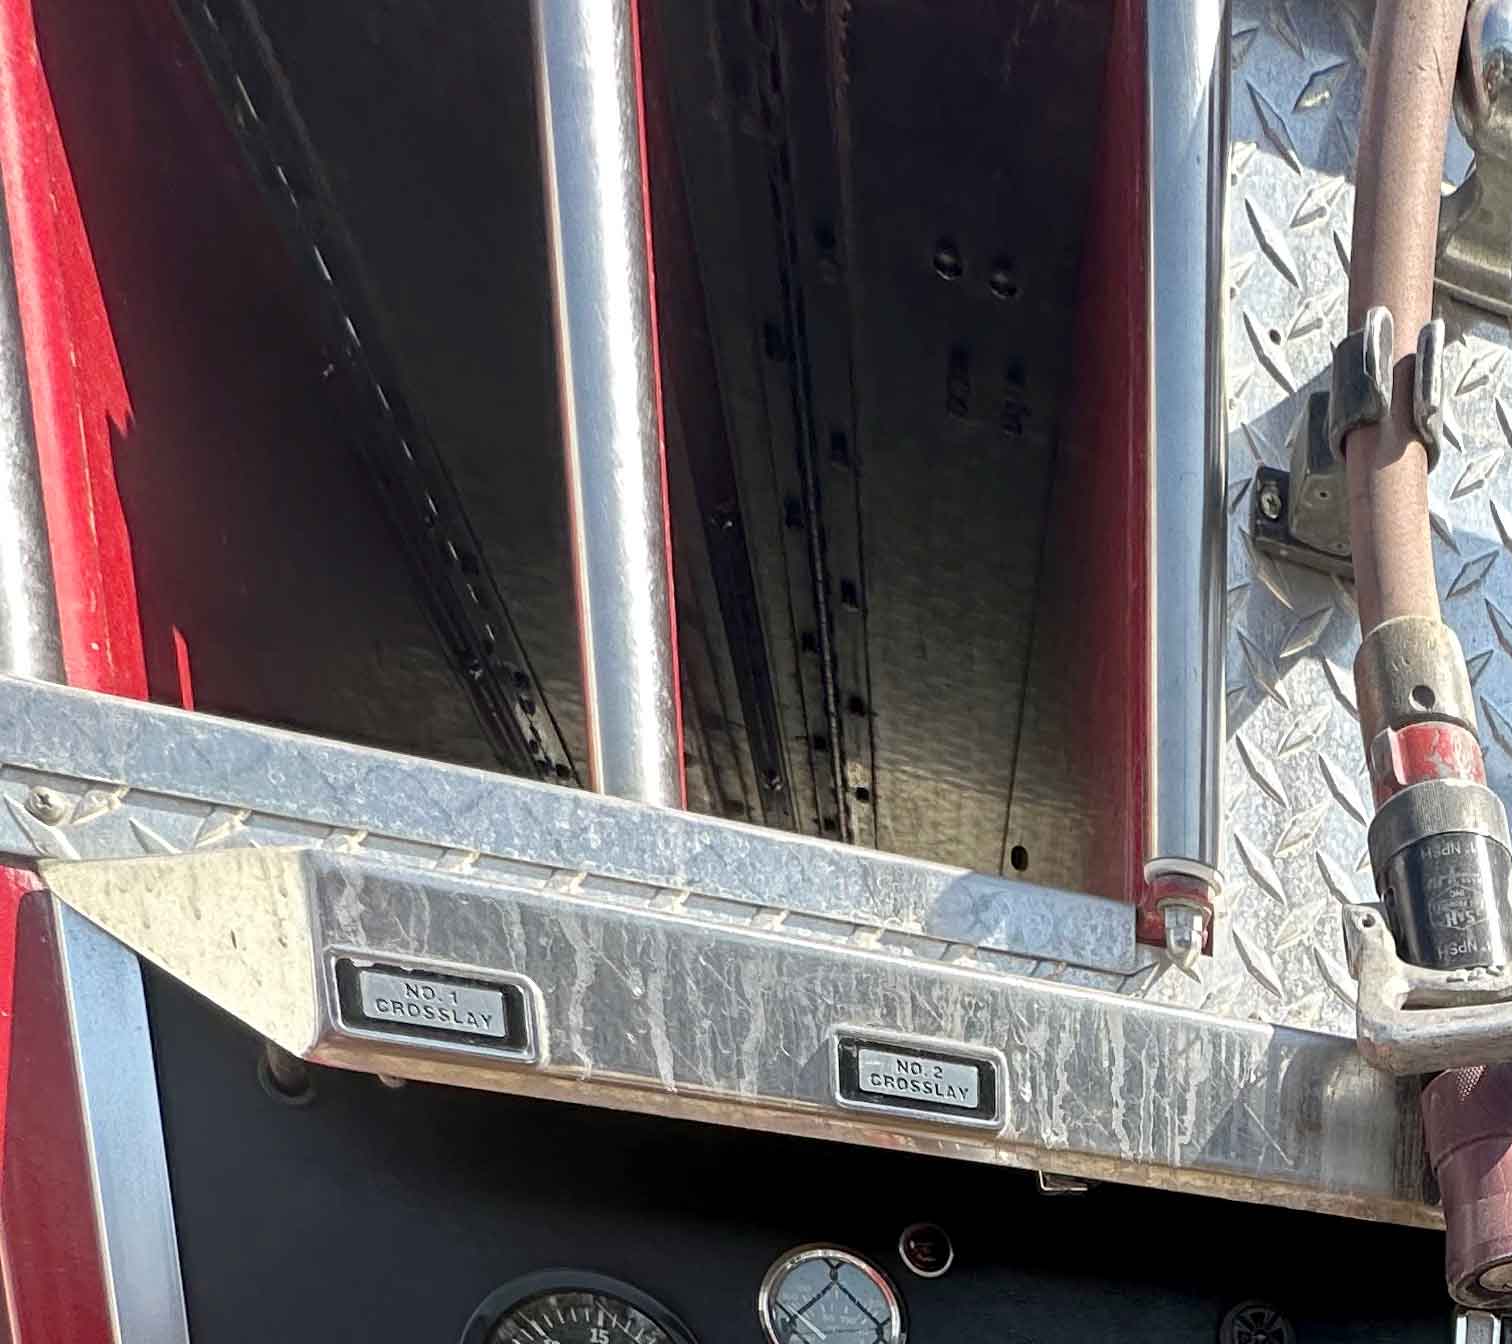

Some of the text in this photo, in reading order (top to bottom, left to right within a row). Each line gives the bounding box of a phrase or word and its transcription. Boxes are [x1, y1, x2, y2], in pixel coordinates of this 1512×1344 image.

[404, 982, 457, 1003] NO. 1
[375, 998, 492, 1030] CROSSLAY
[896, 1059, 943, 1079] NO. 2
[870, 1073, 968, 1099] CROSSLAY
[589, 1327, 609, 1344] 15
